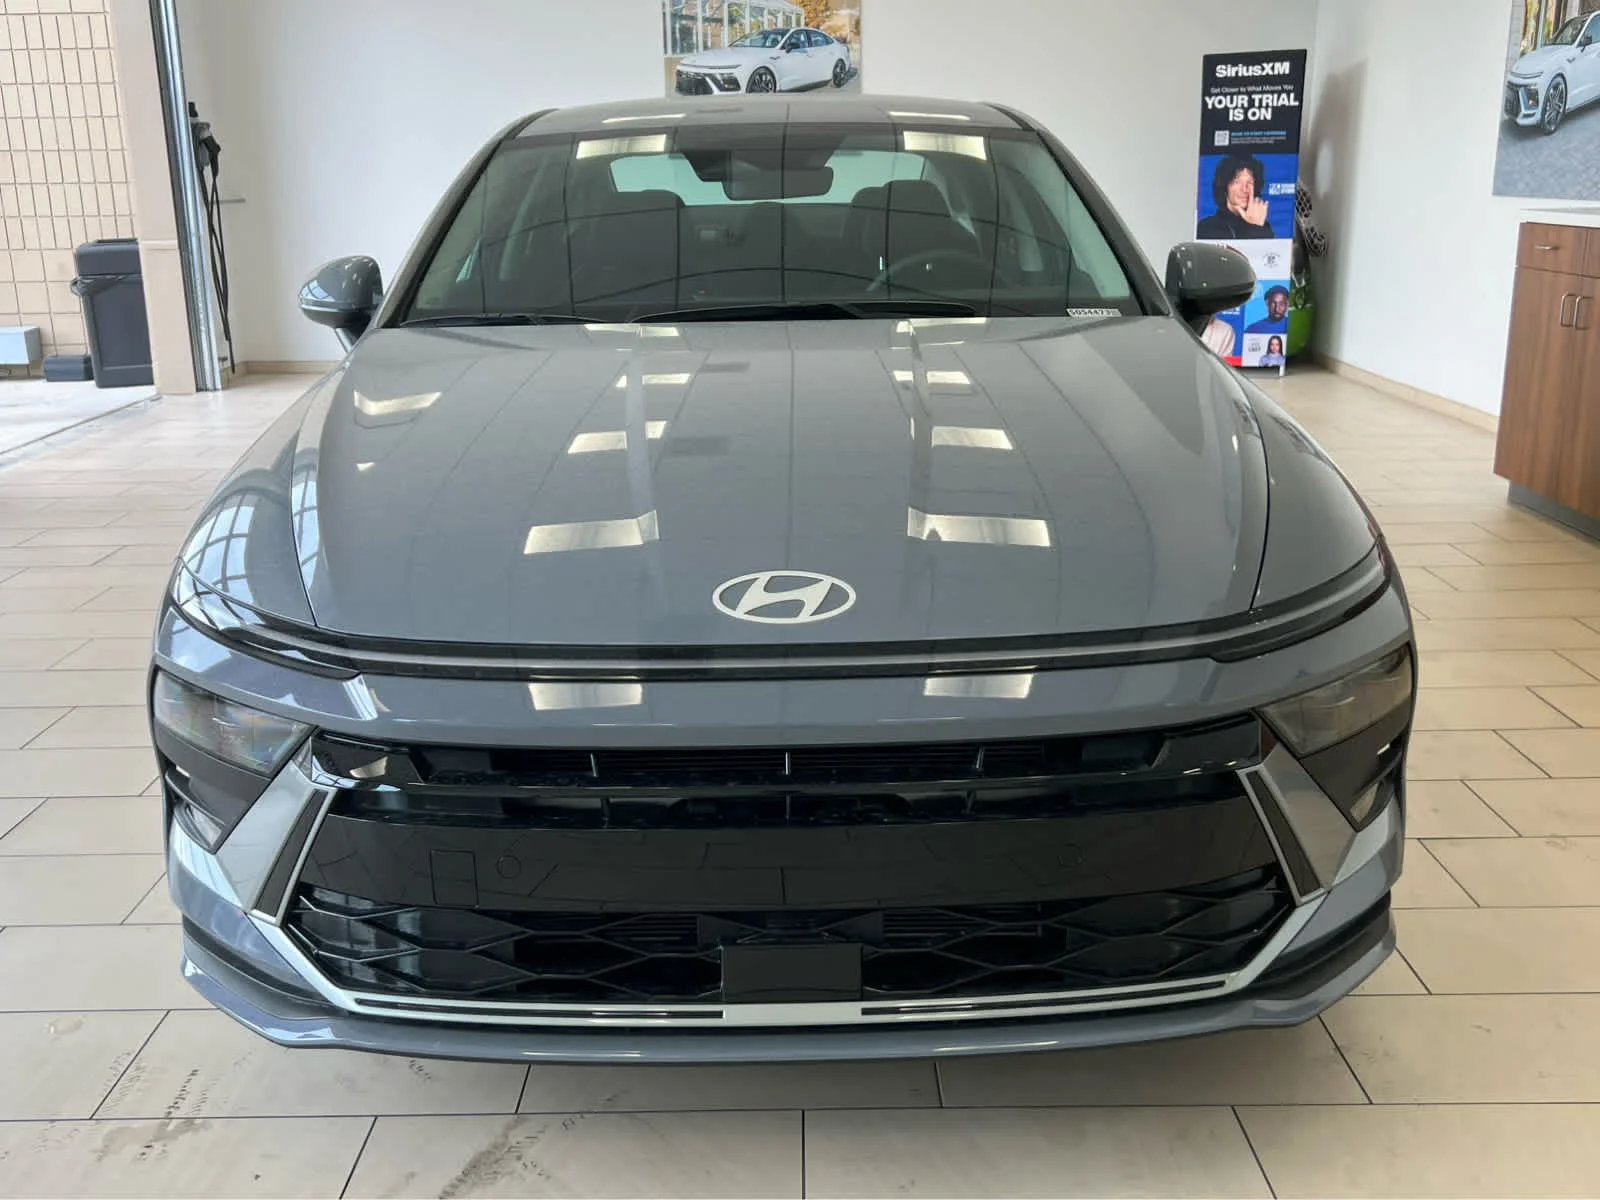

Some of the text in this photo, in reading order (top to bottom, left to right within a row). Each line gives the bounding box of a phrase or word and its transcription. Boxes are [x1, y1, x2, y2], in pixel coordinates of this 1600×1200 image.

[1215, 61, 1290, 77] SiriusXM
[1204, 93, 1299, 109] YOUR TRIAL
[1229, 108, 1272, 121] IS ON
